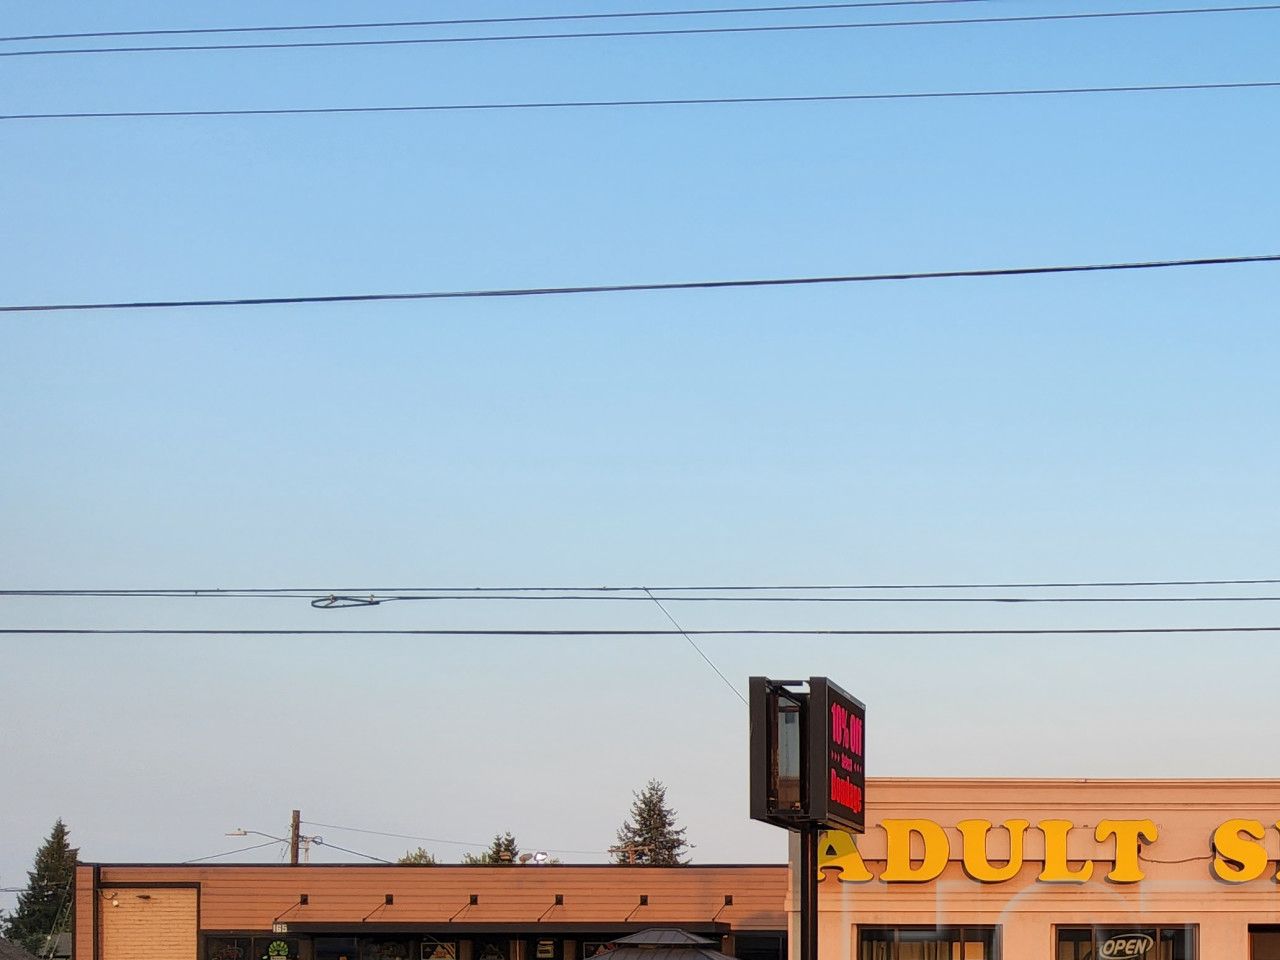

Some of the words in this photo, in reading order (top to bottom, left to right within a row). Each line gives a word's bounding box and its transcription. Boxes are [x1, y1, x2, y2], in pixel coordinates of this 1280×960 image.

[832, 703, 849, 750] 10%
[818, 818, 1159, 884] ADULT
[273, 924, 287, 933] 165
[1103, 939, 1148, 955] OPEN
